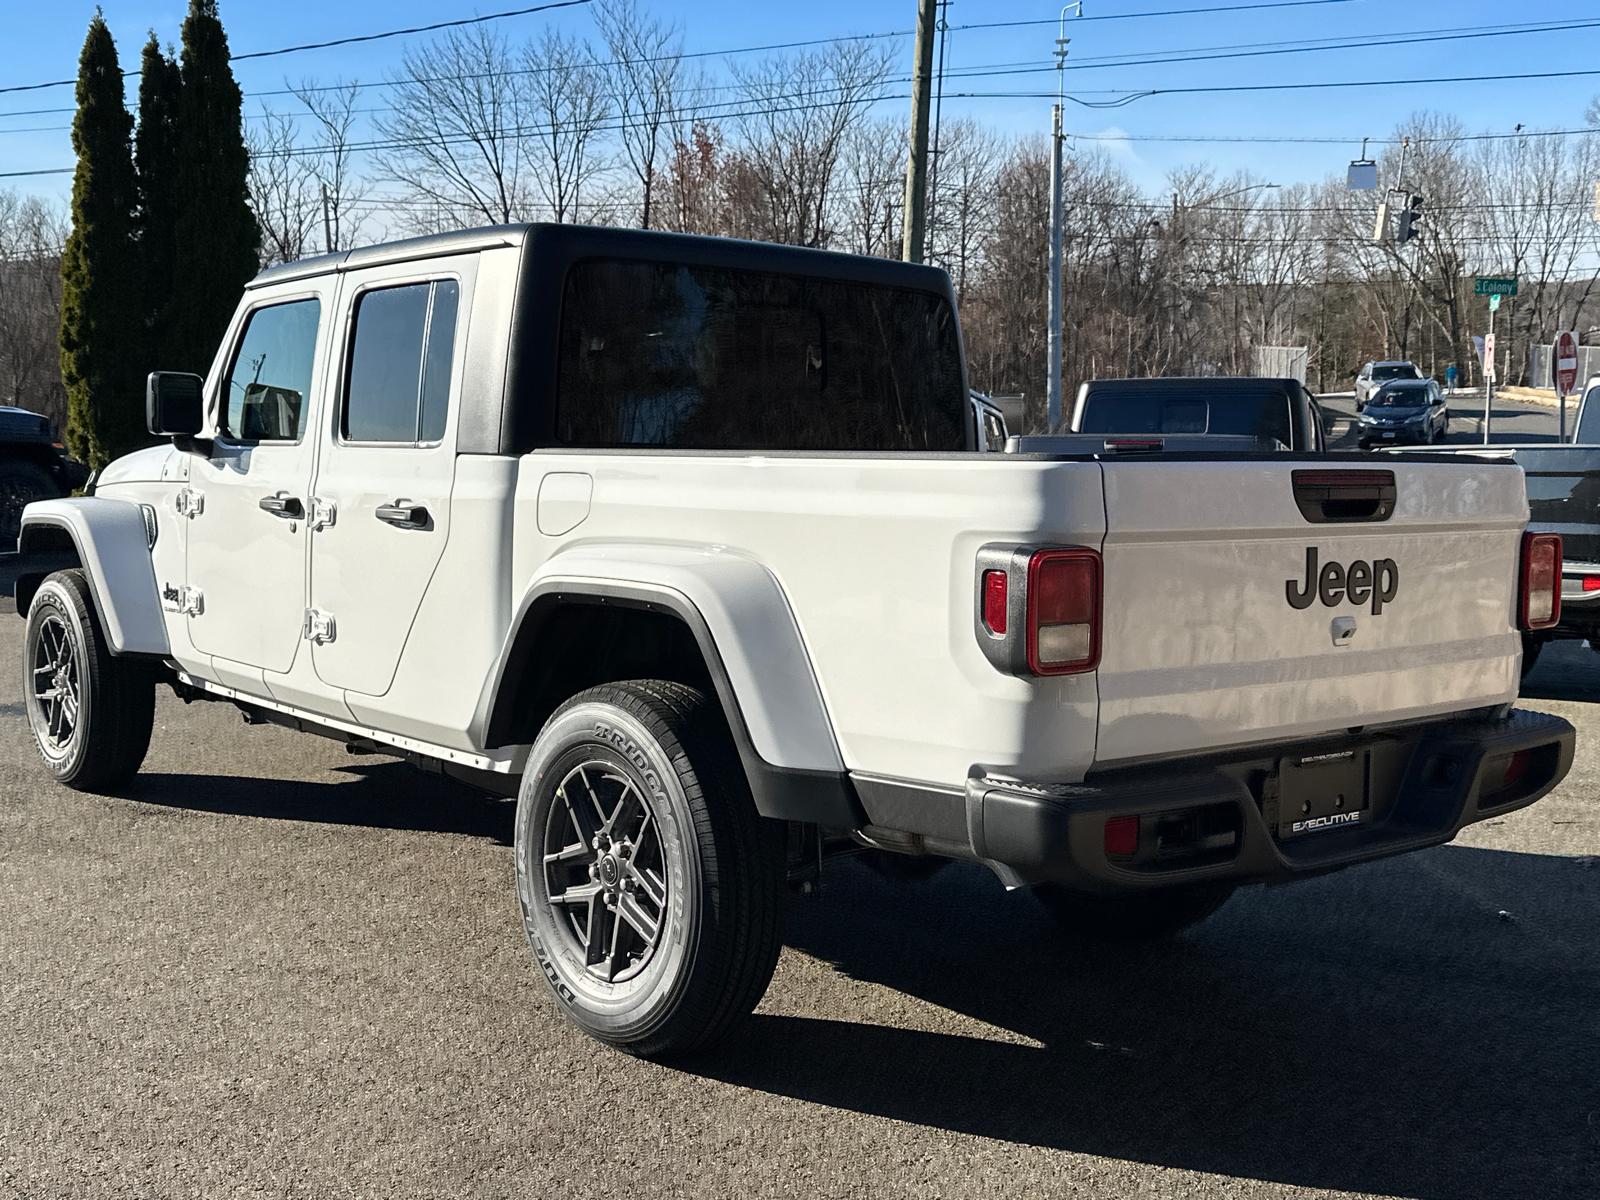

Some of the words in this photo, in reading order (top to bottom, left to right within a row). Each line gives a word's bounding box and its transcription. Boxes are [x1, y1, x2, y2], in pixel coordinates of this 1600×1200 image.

[1286, 547, 1398, 615] Jeep
[593, 722, 684, 945] BRIDGESTONE
[1293, 812, 1360, 832] EXECUTIVE
